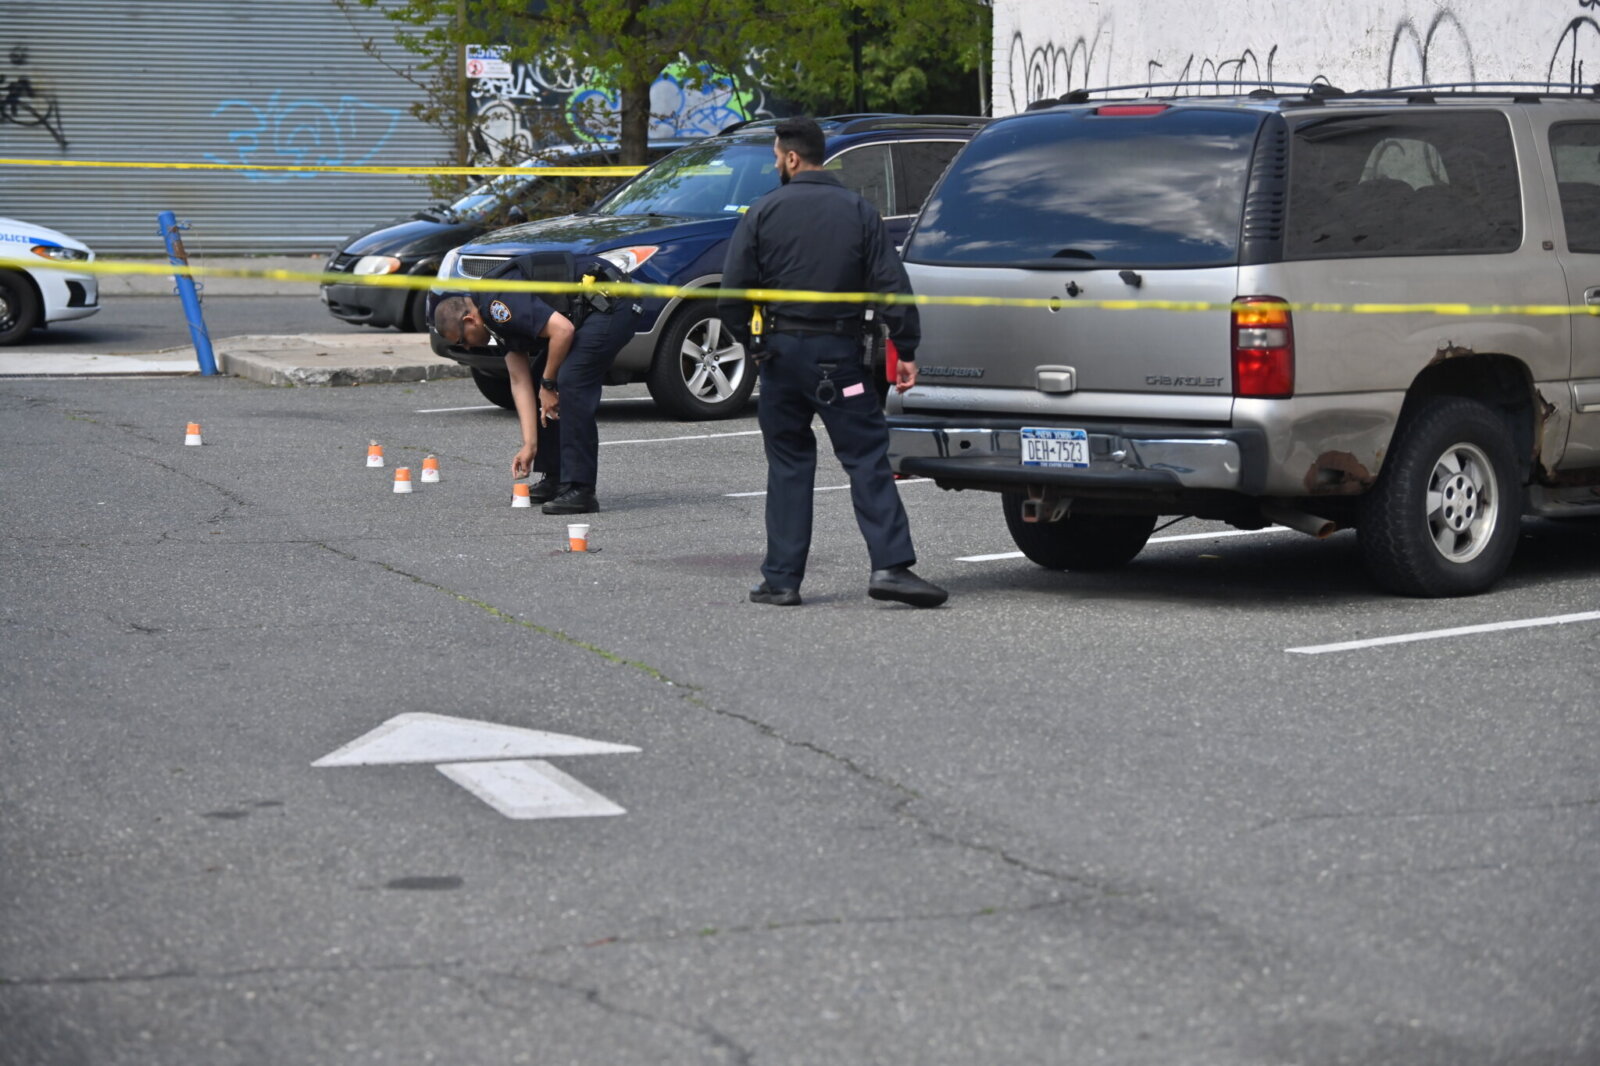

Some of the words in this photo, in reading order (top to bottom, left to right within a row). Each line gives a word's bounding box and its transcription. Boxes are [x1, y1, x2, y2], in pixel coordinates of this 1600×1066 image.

[0, 233, 28, 243] OLICE
[920, 365, 984, 378] SUBURBAN
[1145, 376, 1224, 387] CHEVROLET
